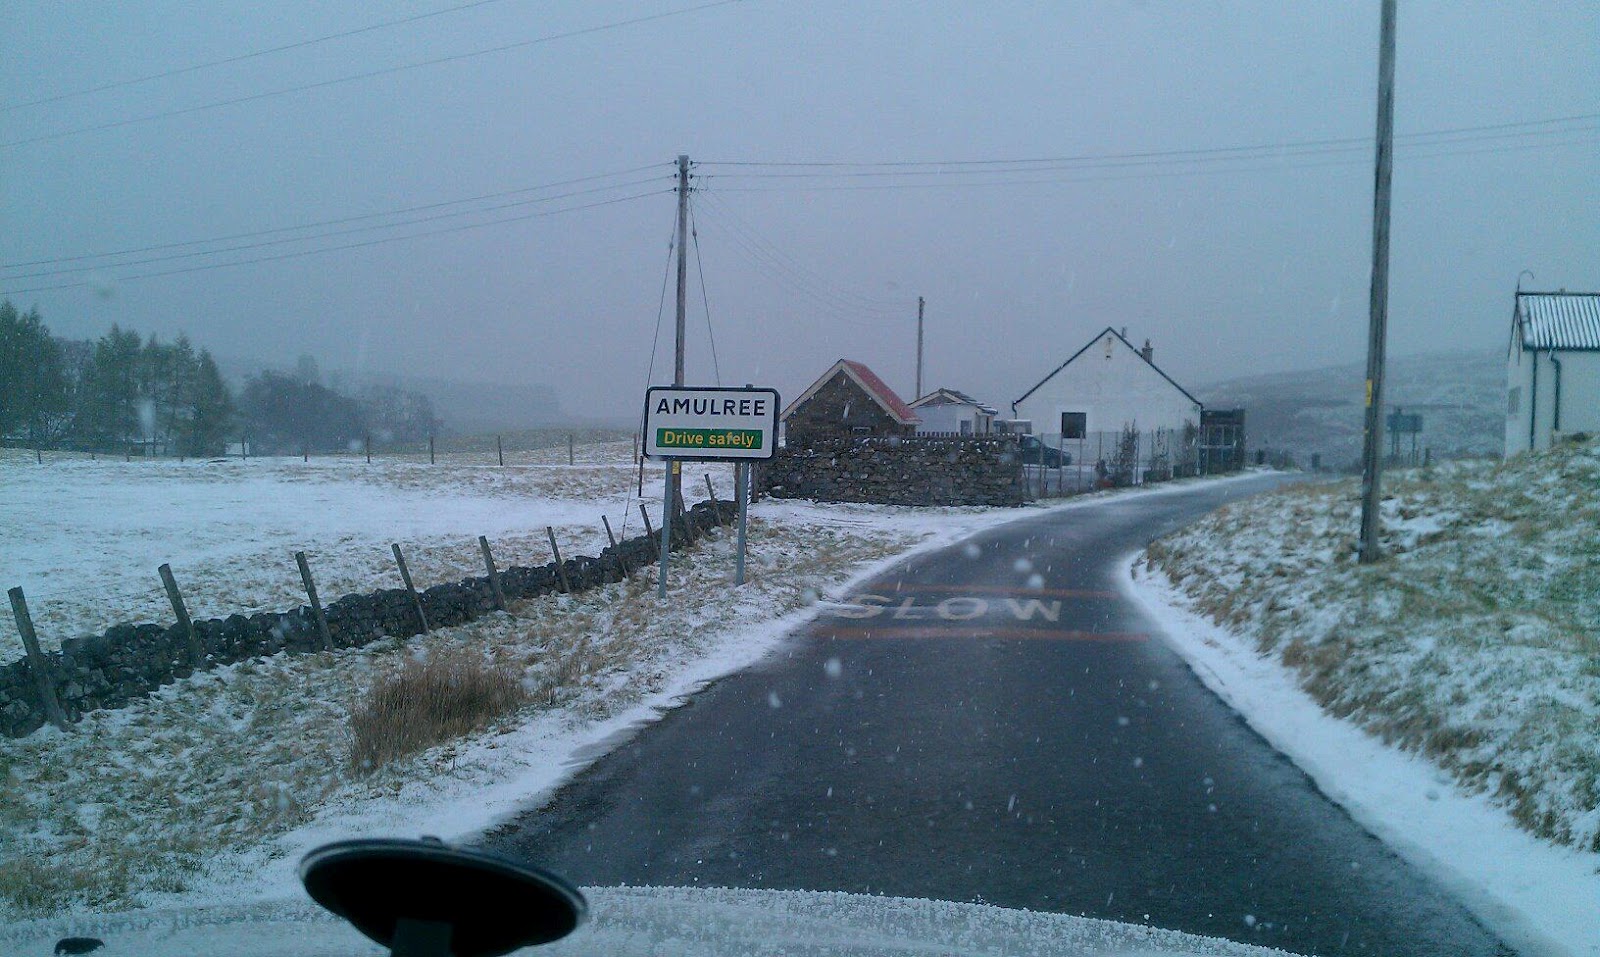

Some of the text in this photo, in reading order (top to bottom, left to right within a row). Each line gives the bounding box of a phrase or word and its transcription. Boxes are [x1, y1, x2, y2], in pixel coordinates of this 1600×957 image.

[656, 398, 765, 416] AMULREE
[664, 431, 754, 447] Drive safely
[832, 594, 1062, 621] SLOW
